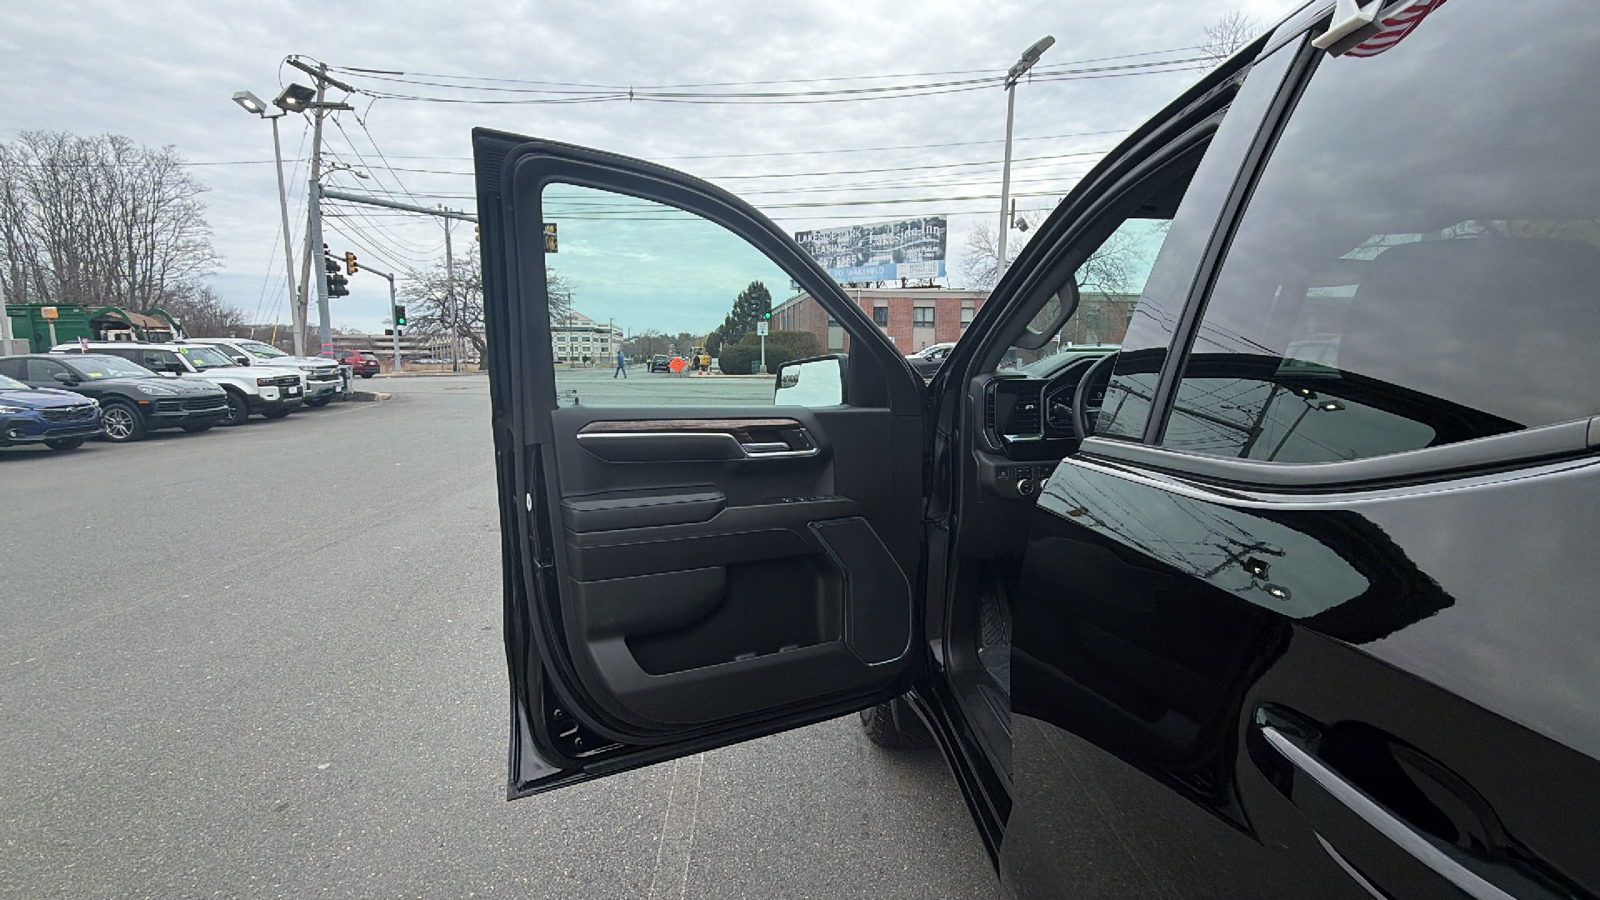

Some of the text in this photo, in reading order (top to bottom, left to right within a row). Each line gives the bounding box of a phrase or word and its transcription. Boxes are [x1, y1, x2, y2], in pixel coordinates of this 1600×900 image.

[921, 219, 940, 236] Inn
[797, 229, 863, 244] LAKESIDE PARK
[811, 243, 846, 256] LEASING
[846, 266, 885, 276] WAKEFIELD
